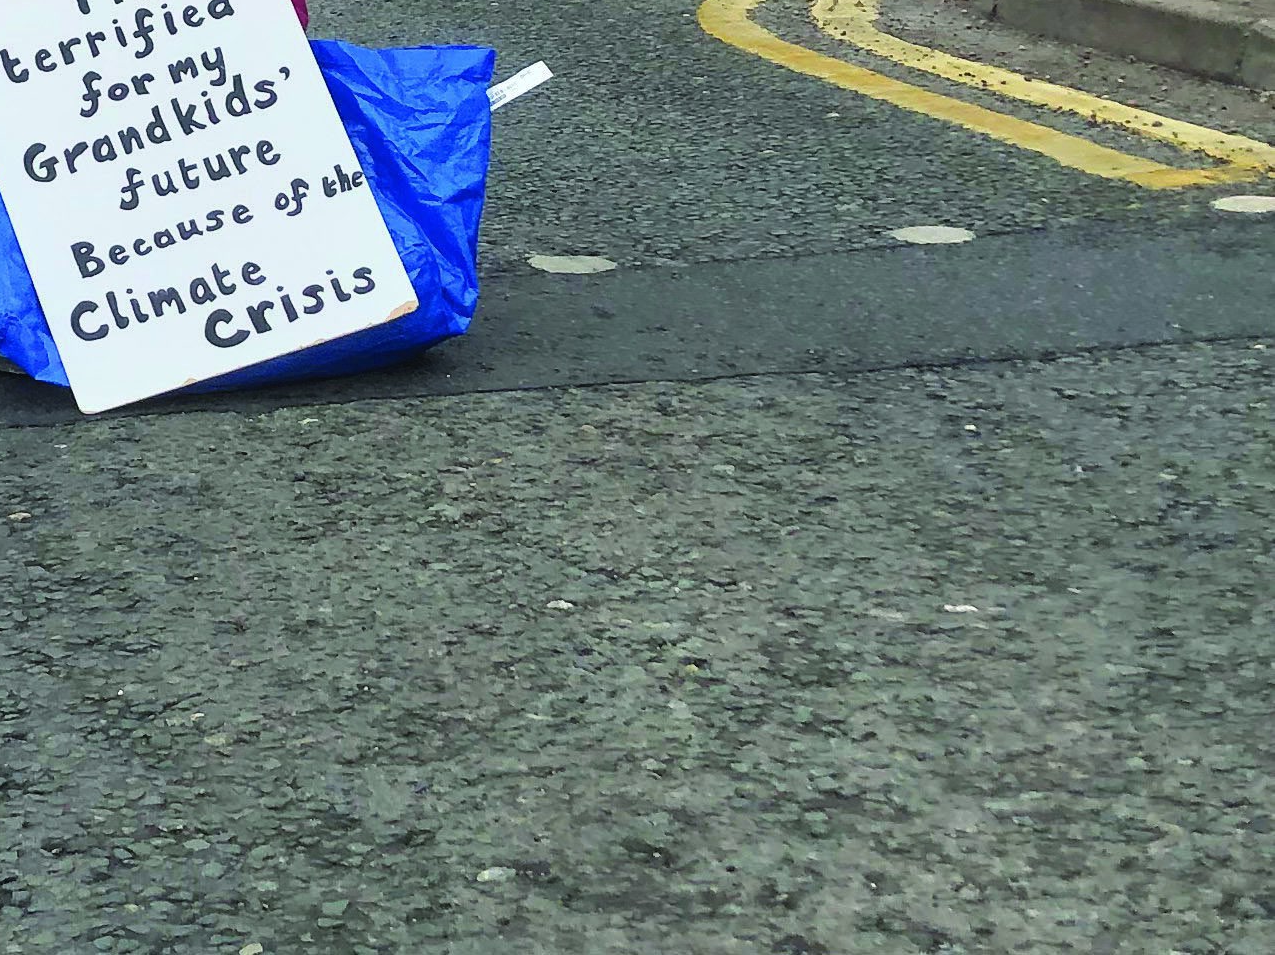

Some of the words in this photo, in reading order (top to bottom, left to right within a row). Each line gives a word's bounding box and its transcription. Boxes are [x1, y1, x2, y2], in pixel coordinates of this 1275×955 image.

[23, 65, 292, 184] Grandkids'
[79, 70, 155, 119] for
[169, 46, 227, 88] my
[119, 135, 282, 211] future
[70, 202, 254, 280] Because
[274, 177, 310, 218] of
[322, 163, 364, 199] the
[69, 258, 266, 342] Climate
[204, 265, 376, 349] Crisis
